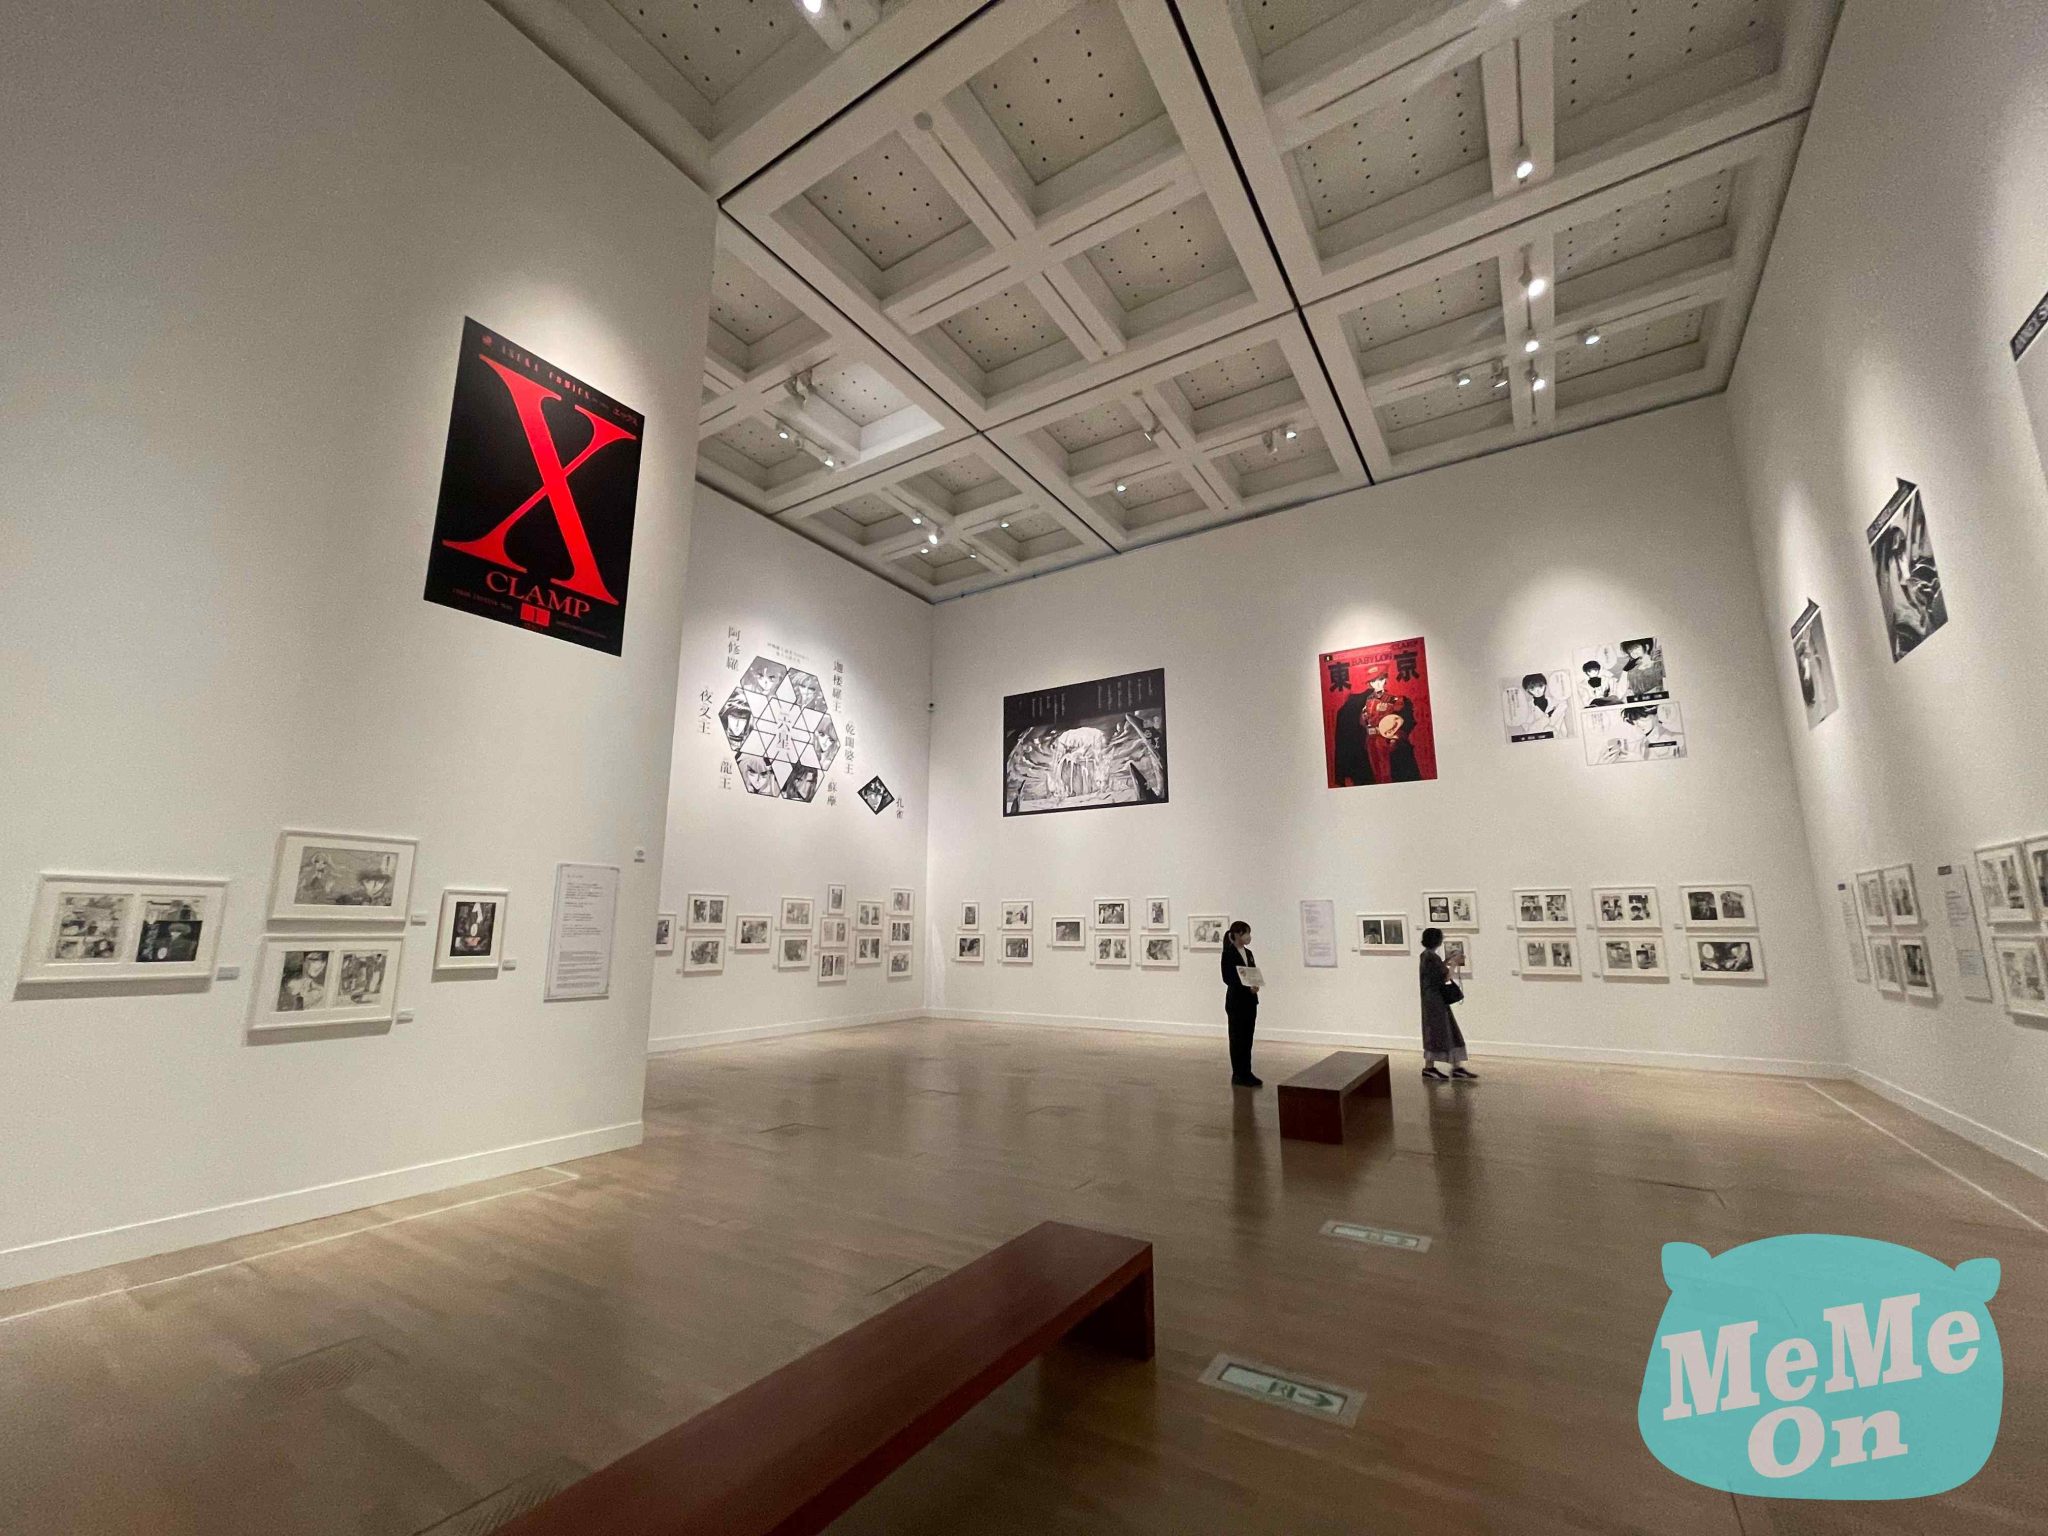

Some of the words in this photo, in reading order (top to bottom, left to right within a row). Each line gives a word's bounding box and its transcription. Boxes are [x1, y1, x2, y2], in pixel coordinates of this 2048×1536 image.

[443, 354, 636, 606] X
[485, 571, 591, 618] CLAMP
[1328, 662, 1352, 692] 東
[1394, 650, 1419, 682] 京
